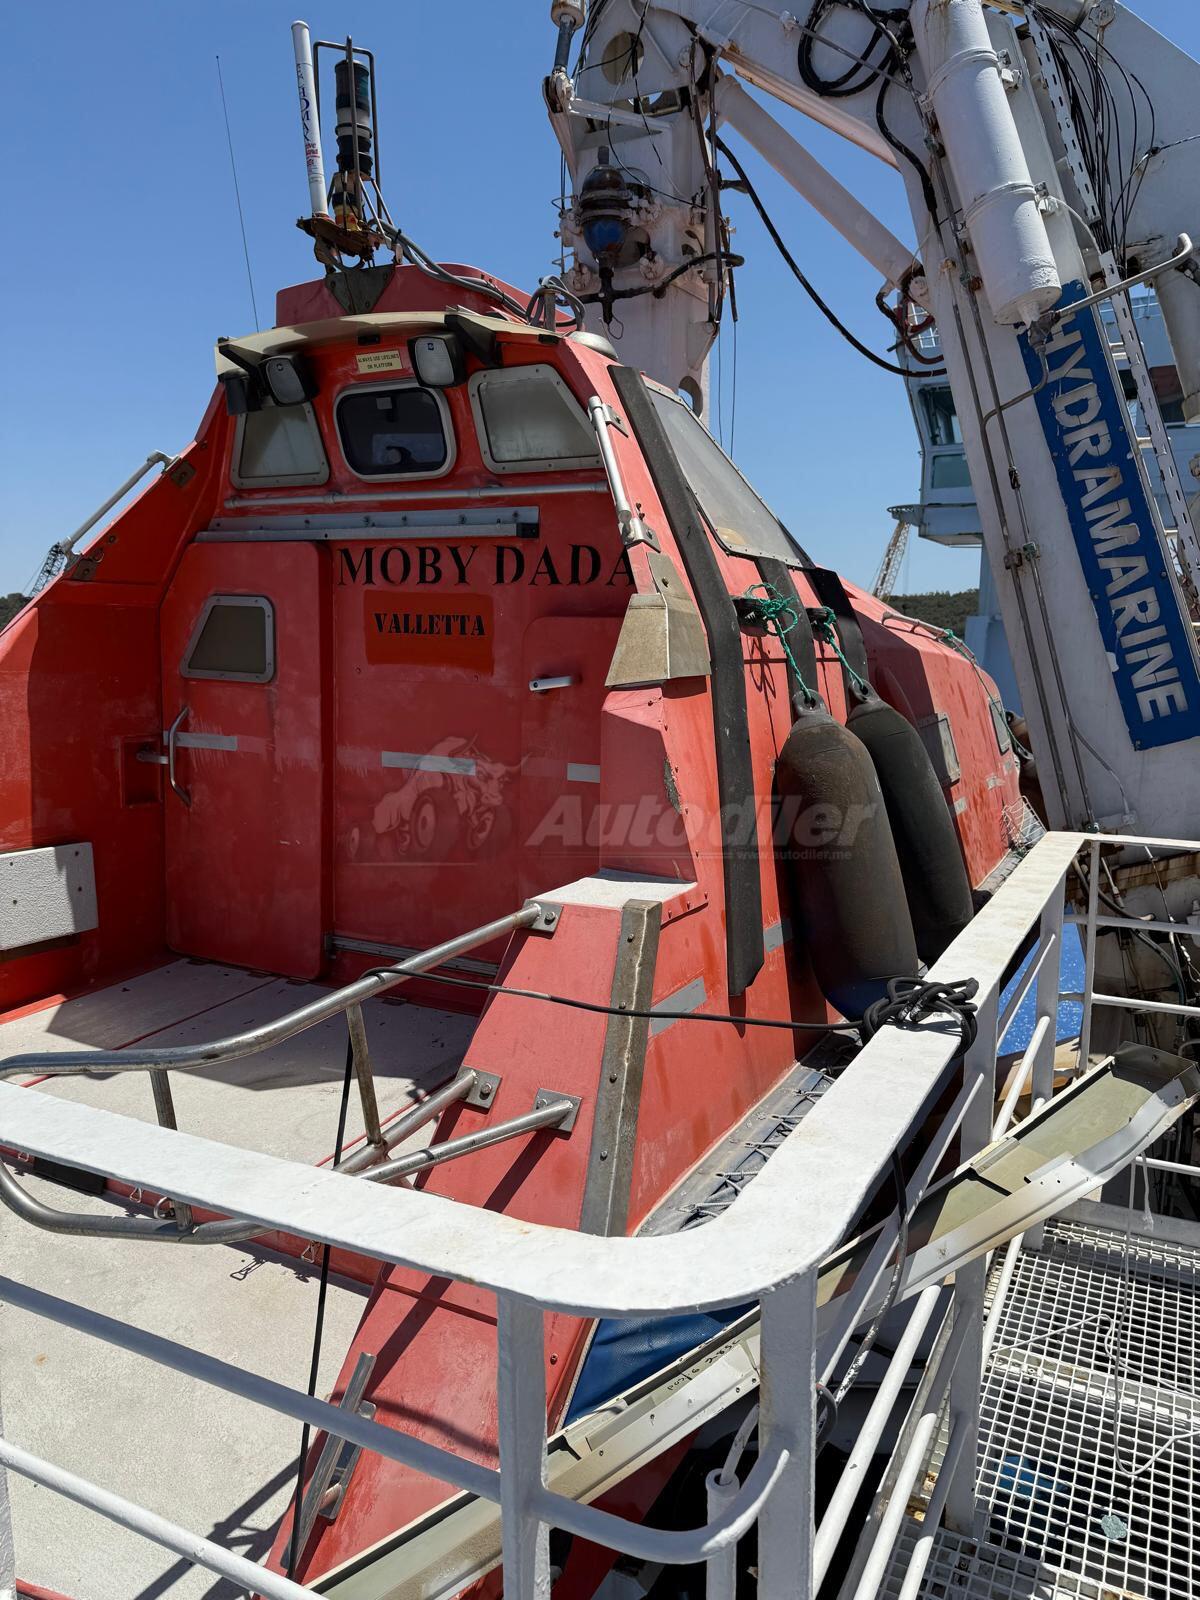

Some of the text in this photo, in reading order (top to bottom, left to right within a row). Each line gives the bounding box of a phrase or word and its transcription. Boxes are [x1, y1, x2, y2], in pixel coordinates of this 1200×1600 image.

[1042, 311, 1188, 722] HYDRAMARINE
[337, 544, 636, 586] MOBY DADA
[374, 613, 486, 636] VALLETTA
